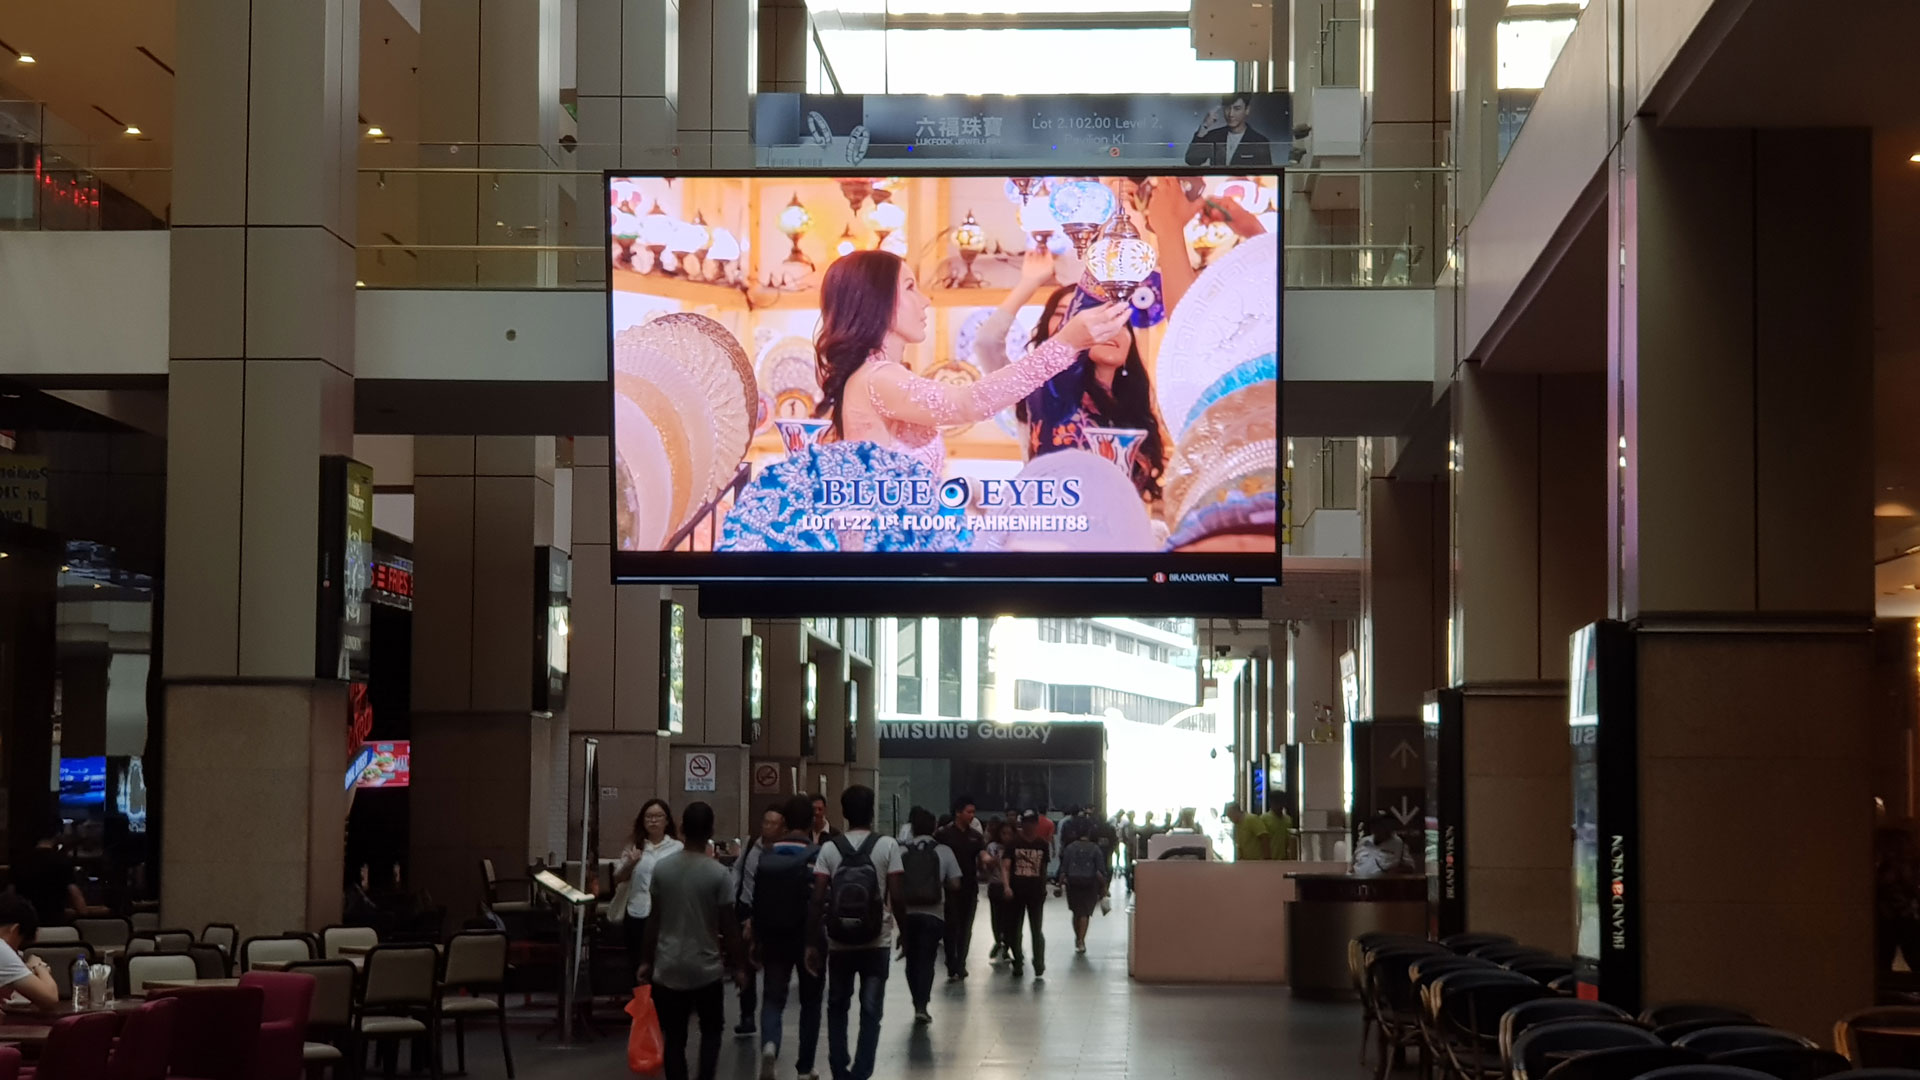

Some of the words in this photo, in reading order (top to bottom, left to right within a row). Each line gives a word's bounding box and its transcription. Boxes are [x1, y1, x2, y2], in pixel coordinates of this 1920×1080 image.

[1032, 118, 1053, 129] Lot
[1057, 118, 1111, 129] 2.102.00
[1115, 117, 1147, 129] Level
[1112, 133, 1129, 145] KL
[822, 478, 931, 506] BLUE
[979, 478, 1080, 506] EYES
[802, 515, 835, 531] LOT
[838, 515, 872, 531] 1-22
[878, 513, 899, 531] 1st
[903, 515, 961, 533] FLOOR,
[967, 515, 1088, 532] FAHRENHEIT88
[876, 722, 969, 739] AMSUNG
[977, 722, 1052, 744] Galaxy
